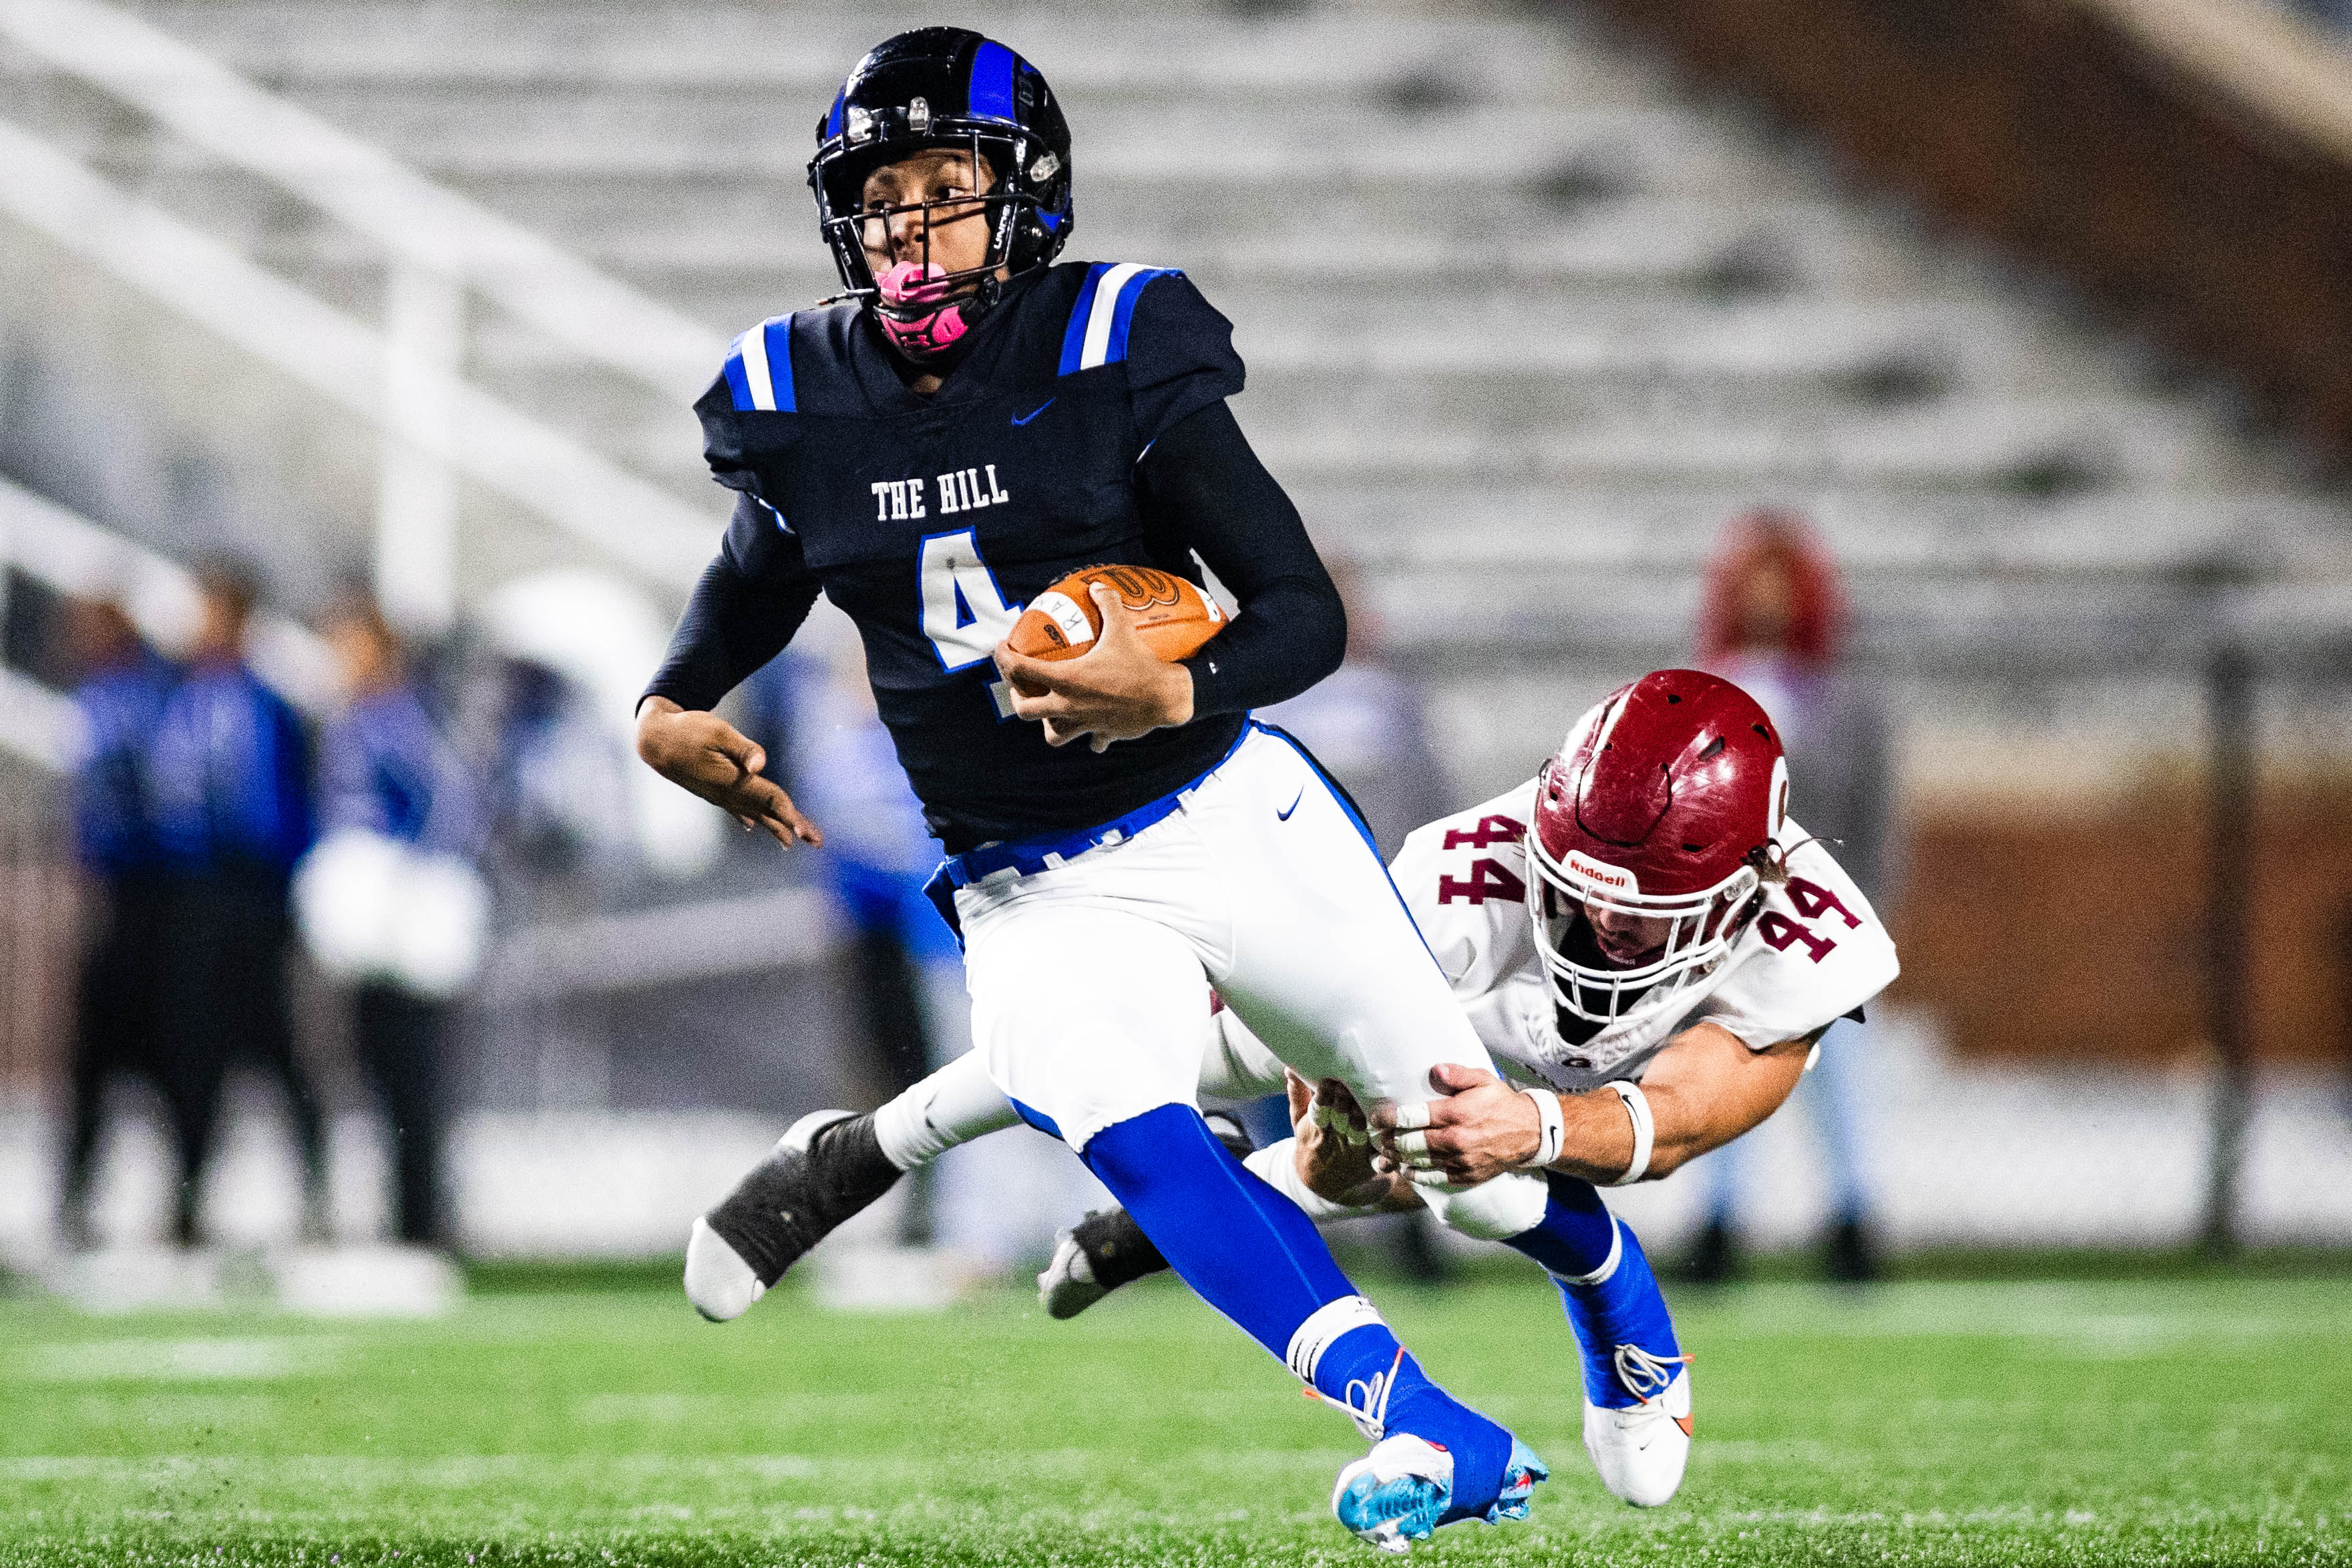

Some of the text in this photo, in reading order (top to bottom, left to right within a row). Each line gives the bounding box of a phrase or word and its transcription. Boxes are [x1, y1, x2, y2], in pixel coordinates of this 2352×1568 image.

[993, 203, 1012, 250] UNDE
[871, 464, 1009, 522] THE HILL
[916, 524, 1025, 725] 4
[1437, 813, 1528, 906] 44
[1569, 858, 1625, 888] Riddell
[1756, 875, 1863, 964] 44
